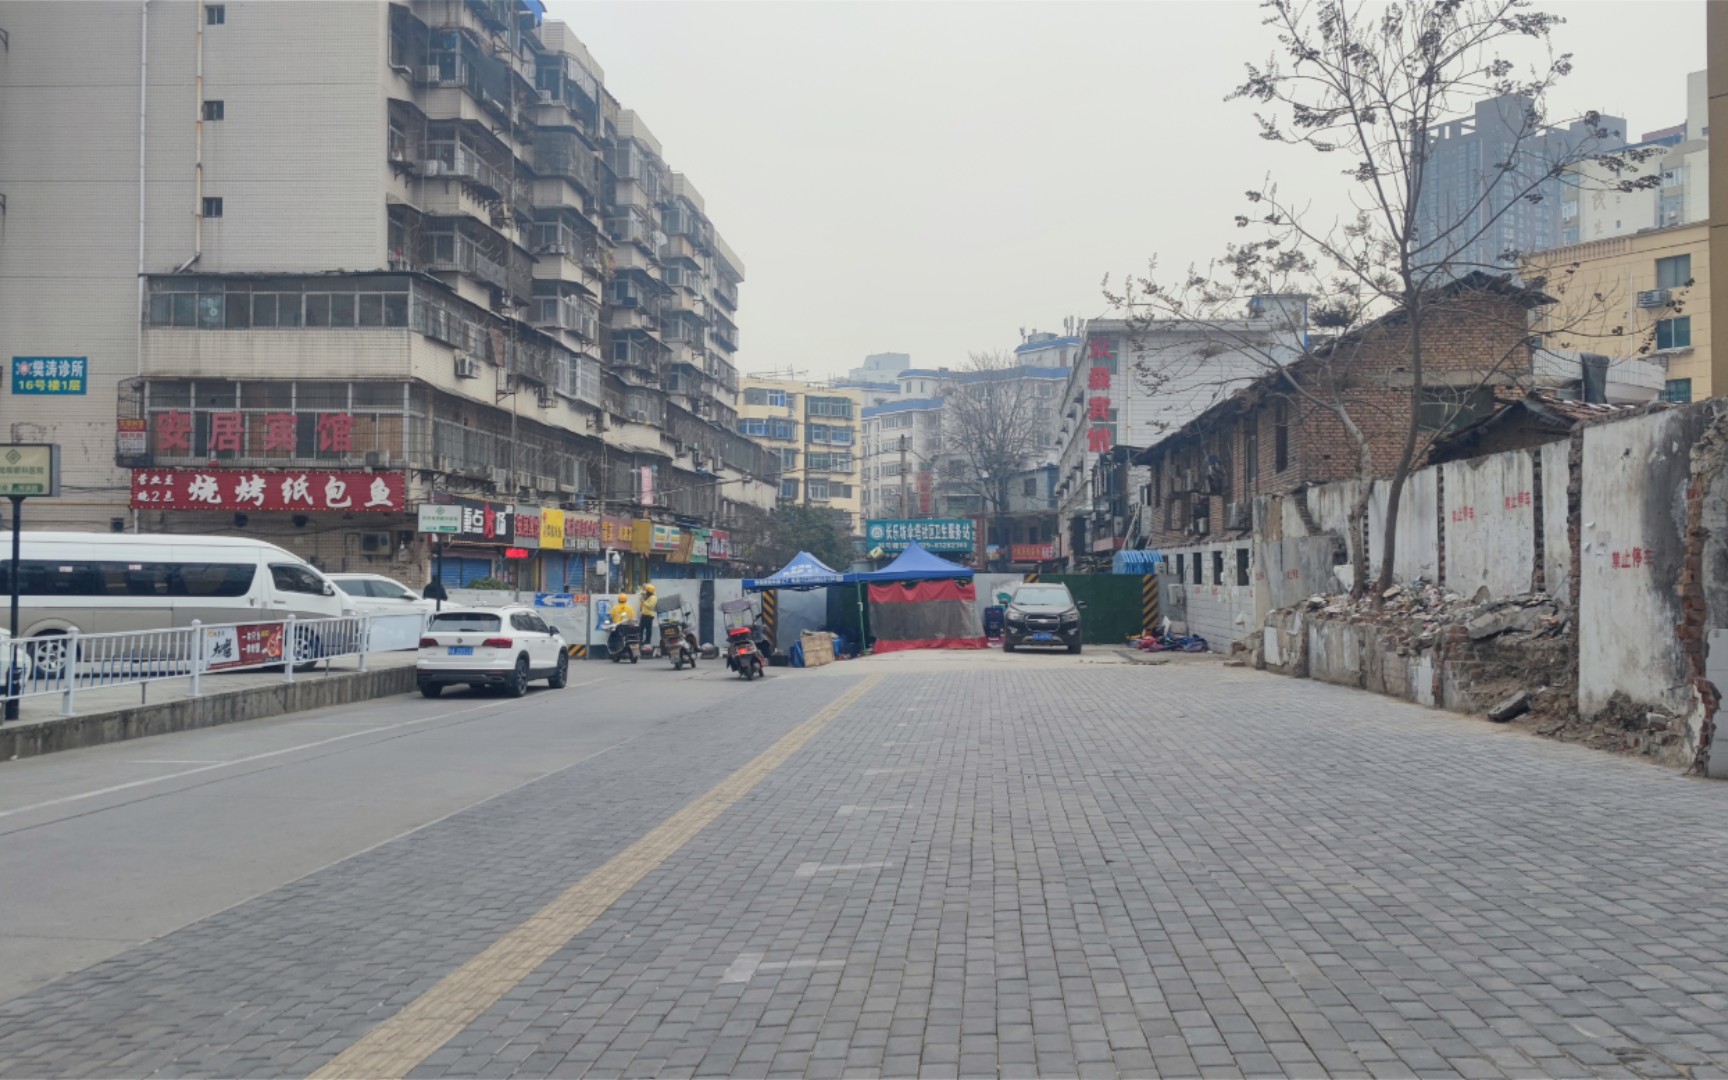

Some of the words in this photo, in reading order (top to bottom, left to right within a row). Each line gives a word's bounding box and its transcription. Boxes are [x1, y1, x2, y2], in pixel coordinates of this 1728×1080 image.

[18, 380, 81, 391] 16号楼1层
[157, 409, 354, 452] 安居宾馆
[187, 474, 394, 508] 烧烤纸包鱼
[1612, 547, 1654, 570] 禁止停车
